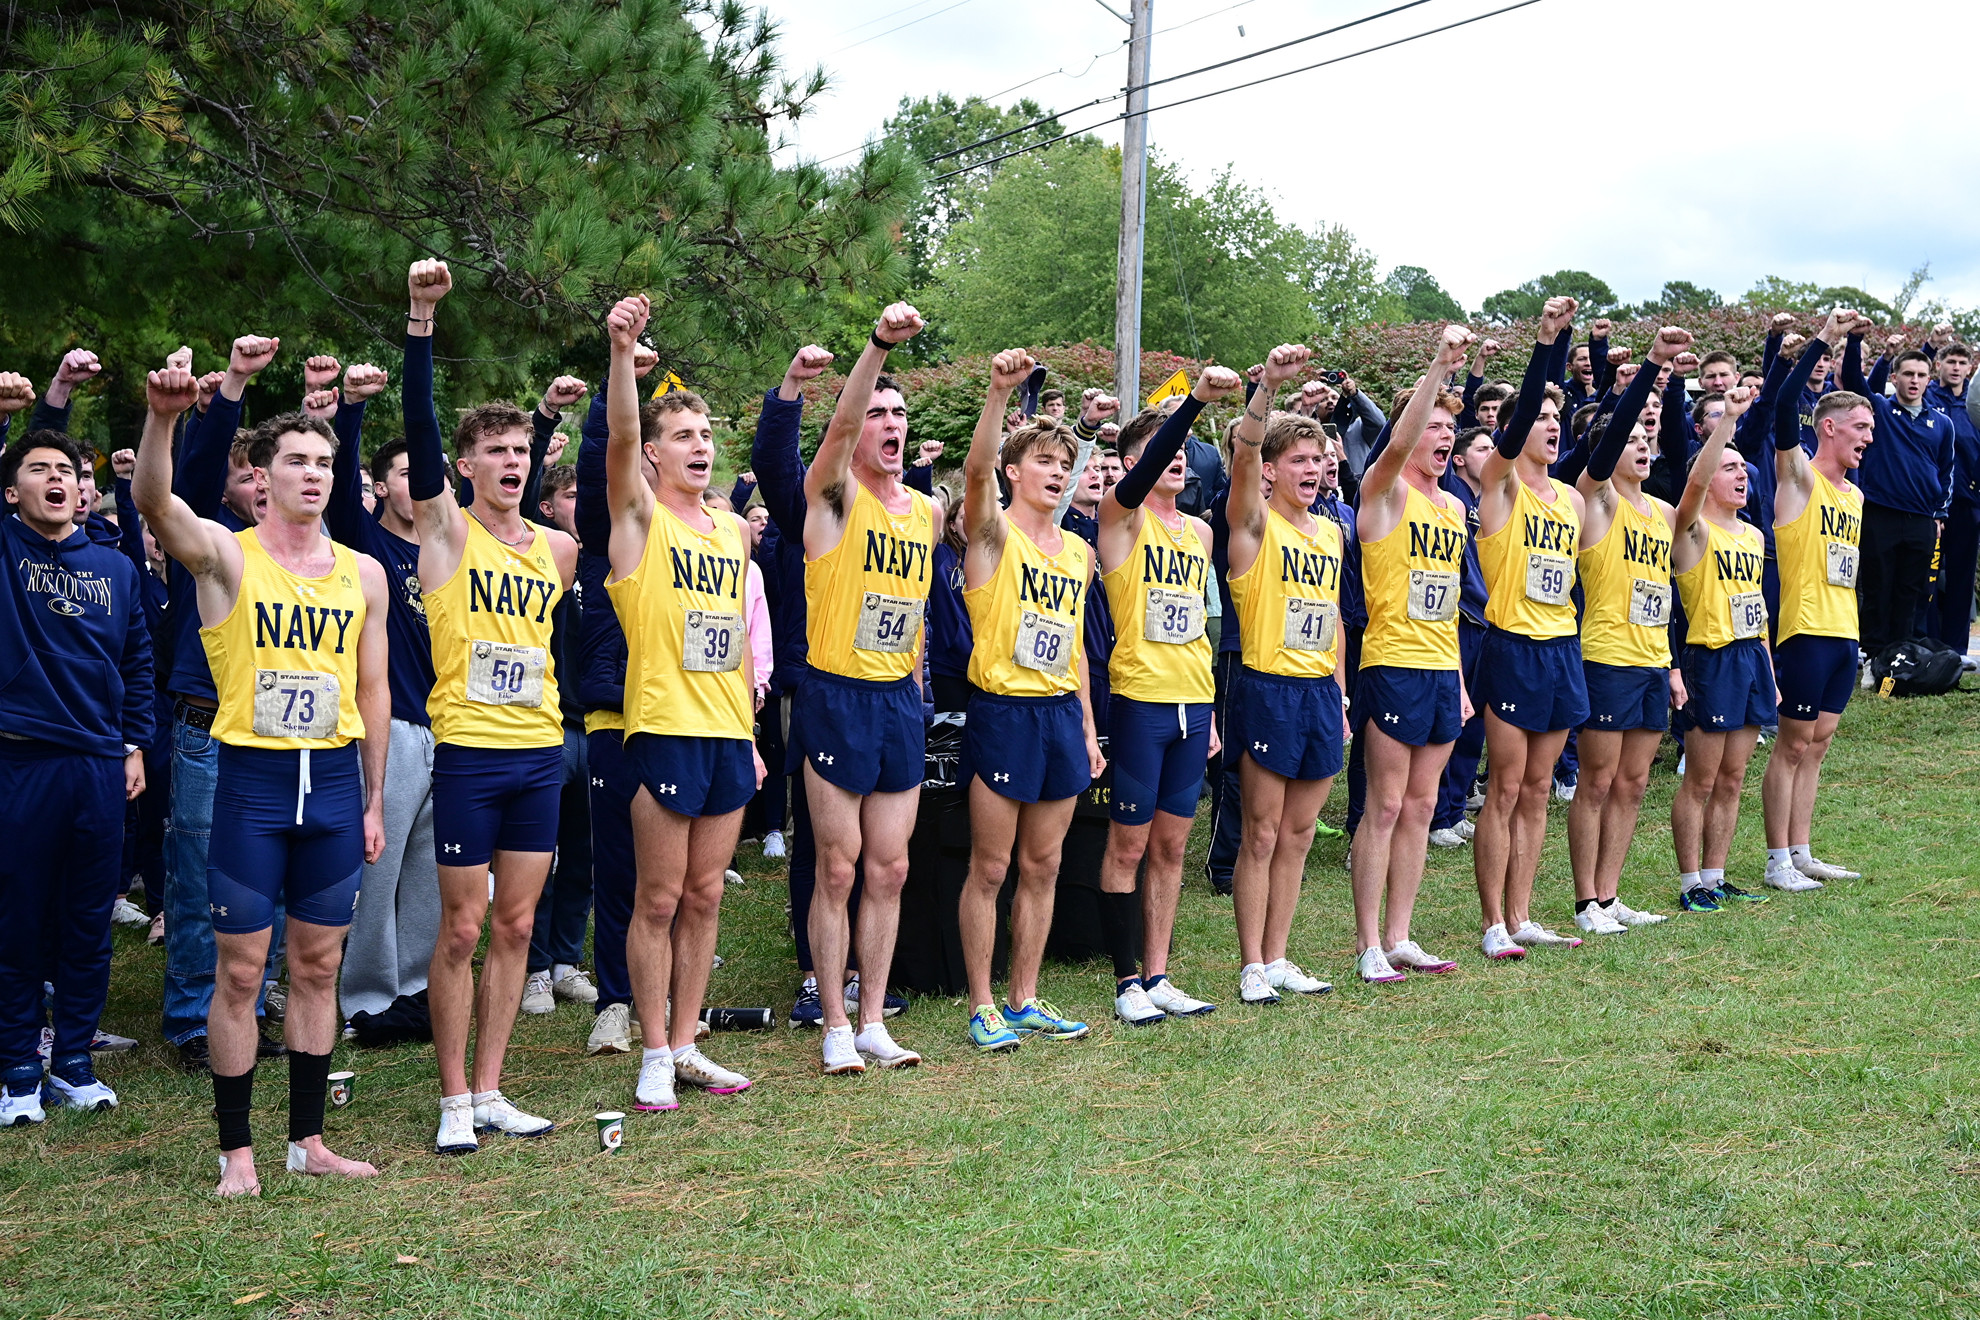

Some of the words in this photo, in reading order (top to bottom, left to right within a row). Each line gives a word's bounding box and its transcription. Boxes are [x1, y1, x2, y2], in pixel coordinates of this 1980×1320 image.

[1523, 513, 1575, 556] NAVY
[1820, 505, 1860, 544] NAVY
[864, 529, 928, 582] NAVY
[1409, 521, 1467, 567] NAVY
[1623, 525, 1670, 572] NAVY
[670, 546, 740, 599] NAVY
[1143, 544, 1205, 591] NAVY
[1281, 545, 1339, 591] NAVY
[1541, 568, 1563, 594] 59
[1714, 550, 1763, 585] NAVY
[1839, 556, 1853, 578] 46
[469, 568, 556, 623] NAVY
[1020, 562, 1083, 616] NAVY
[1424, 584, 1448, 610] 67
[1643, 593, 1662, 618] 43
[255, 601, 354, 654] NAVY
[877, 610, 907, 641] 54
[1039, 617, 1054, 626] STAR
[1163, 604, 1189, 633] 35
[1300, 613, 1324, 640] 41
[704, 627, 730, 659] 39
[1033, 630, 1061, 662] 68
[491, 659, 525, 693] 50
[280, 688, 315, 723] 73
[498, 692, 514, 700] Eike
[283, 722, 310, 732] Skemp
